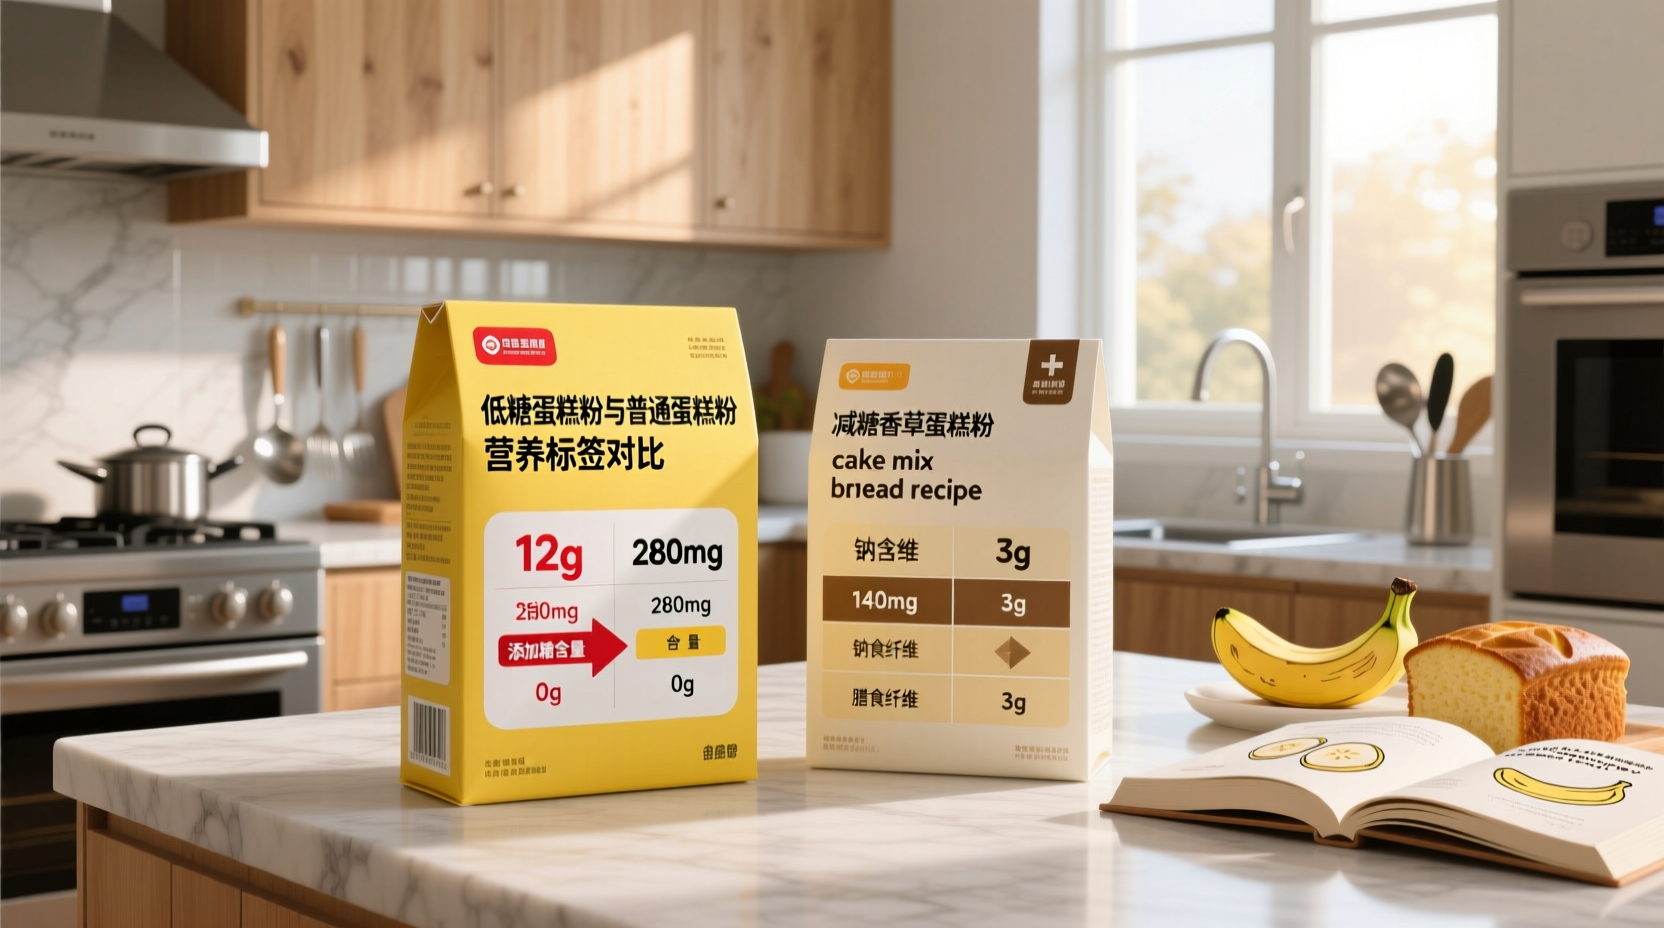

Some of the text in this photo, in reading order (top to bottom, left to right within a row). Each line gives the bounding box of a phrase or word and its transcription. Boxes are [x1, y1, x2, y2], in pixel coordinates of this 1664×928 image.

[481, 394, 737, 426] 低糖蛋糕粉与普通蛋糕粉
[831, 410, 994, 438] 减糖香草蛋糕粉
[484, 435, 665, 472] 营养标签对比
[832, 448, 934, 471] cake mix
[911, 478, 983, 506] recipe
[515, 533, 583, 581] 12g
[632, 537, 723, 571] 280mg
[995, 537, 1031, 571] 3g
[651, 595, 711, 617] 280mg
[852, 590, 918, 615] 140mg
[1001, 593, 1026, 617] 3g
[535, 682, 562, 706] 0g
[671, 674, 694, 697] 0g
[1001, 691, 1026, 716] 3g
